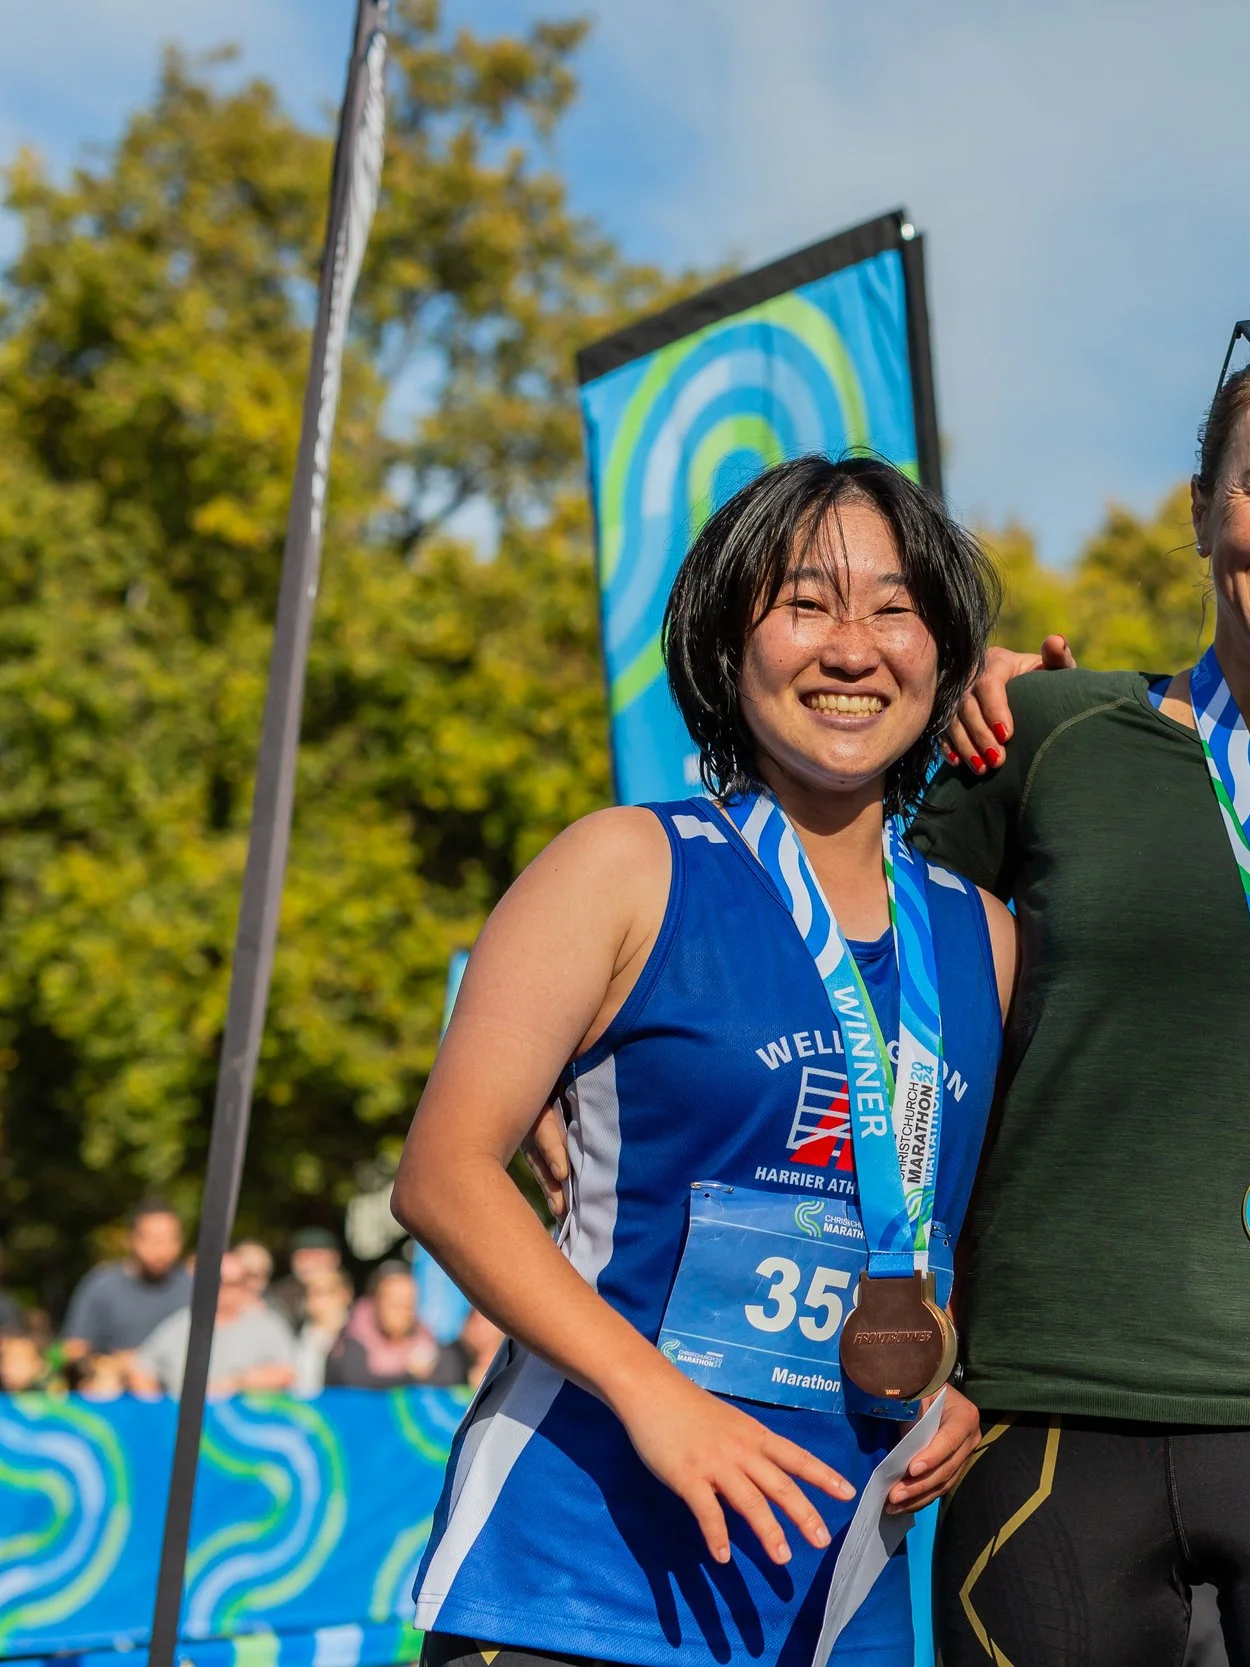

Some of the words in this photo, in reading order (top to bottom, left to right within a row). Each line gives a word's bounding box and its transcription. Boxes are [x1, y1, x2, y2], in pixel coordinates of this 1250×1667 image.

[833, 986, 888, 1138] WINNER
[911, 1061, 924, 1082] 20
[907, 1085, 934, 1184] MARATHON
[923, 1064, 935, 1085] 24
[755, 1166, 825, 1189] HARRIER
[827, 1179, 857, 1195] ATH
[771, 1366, 841, 1393] Marathon
